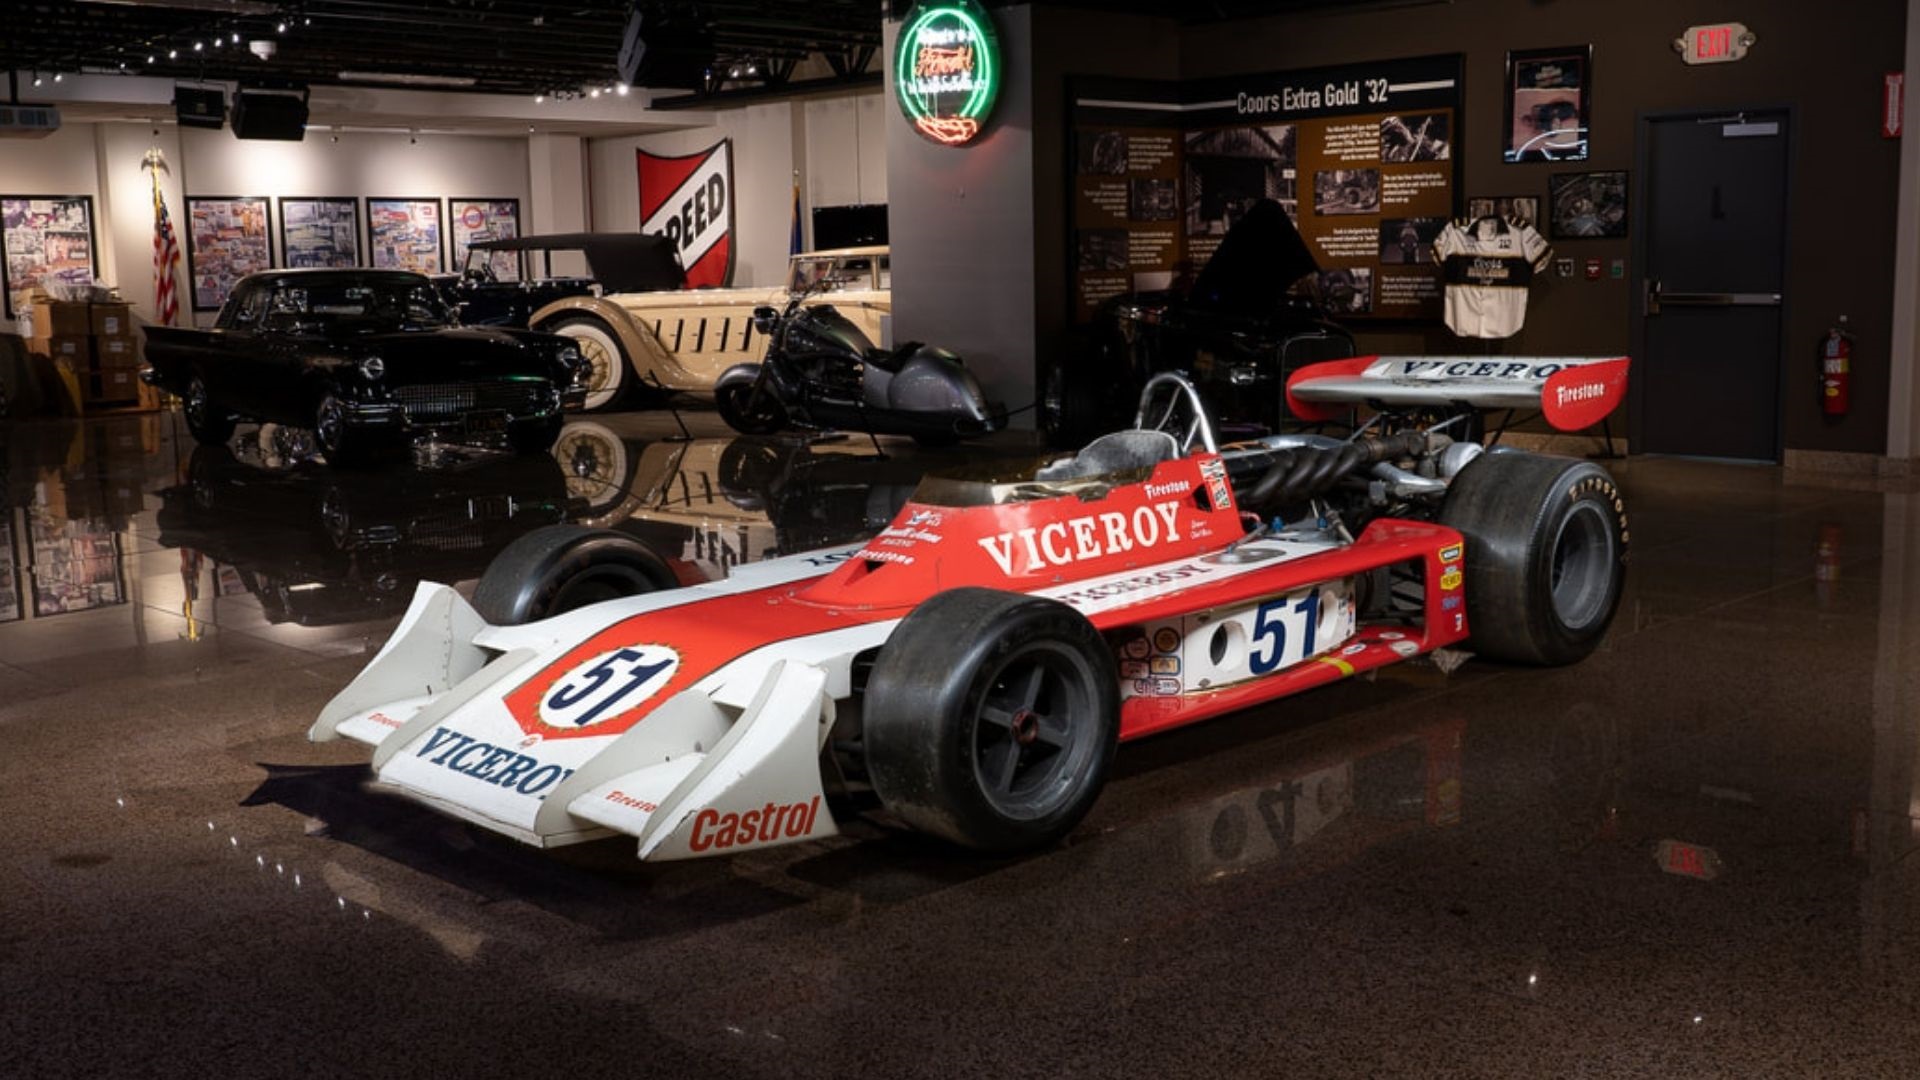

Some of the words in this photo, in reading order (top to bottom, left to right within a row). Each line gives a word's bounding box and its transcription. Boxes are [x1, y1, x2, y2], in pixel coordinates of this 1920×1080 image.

[1697, 27, 1732, 58] EXIT
[1237, 91, 1280, 114] Coors
[1283, 87, 1320, 110] Extra
[1325, 82, 1359, 107] Gold
[654, 172, 725, 251] PEED
[1403, 360, 1580, 377] VCERO
[1556, 382, 1605, 407] Firestone
[977, 501, 1181, 577] VICEROY
[1249, 586, 1320, 675] 51
[548, 648, 675, 726] 51
[689, 795, 821, 852] Castrol
